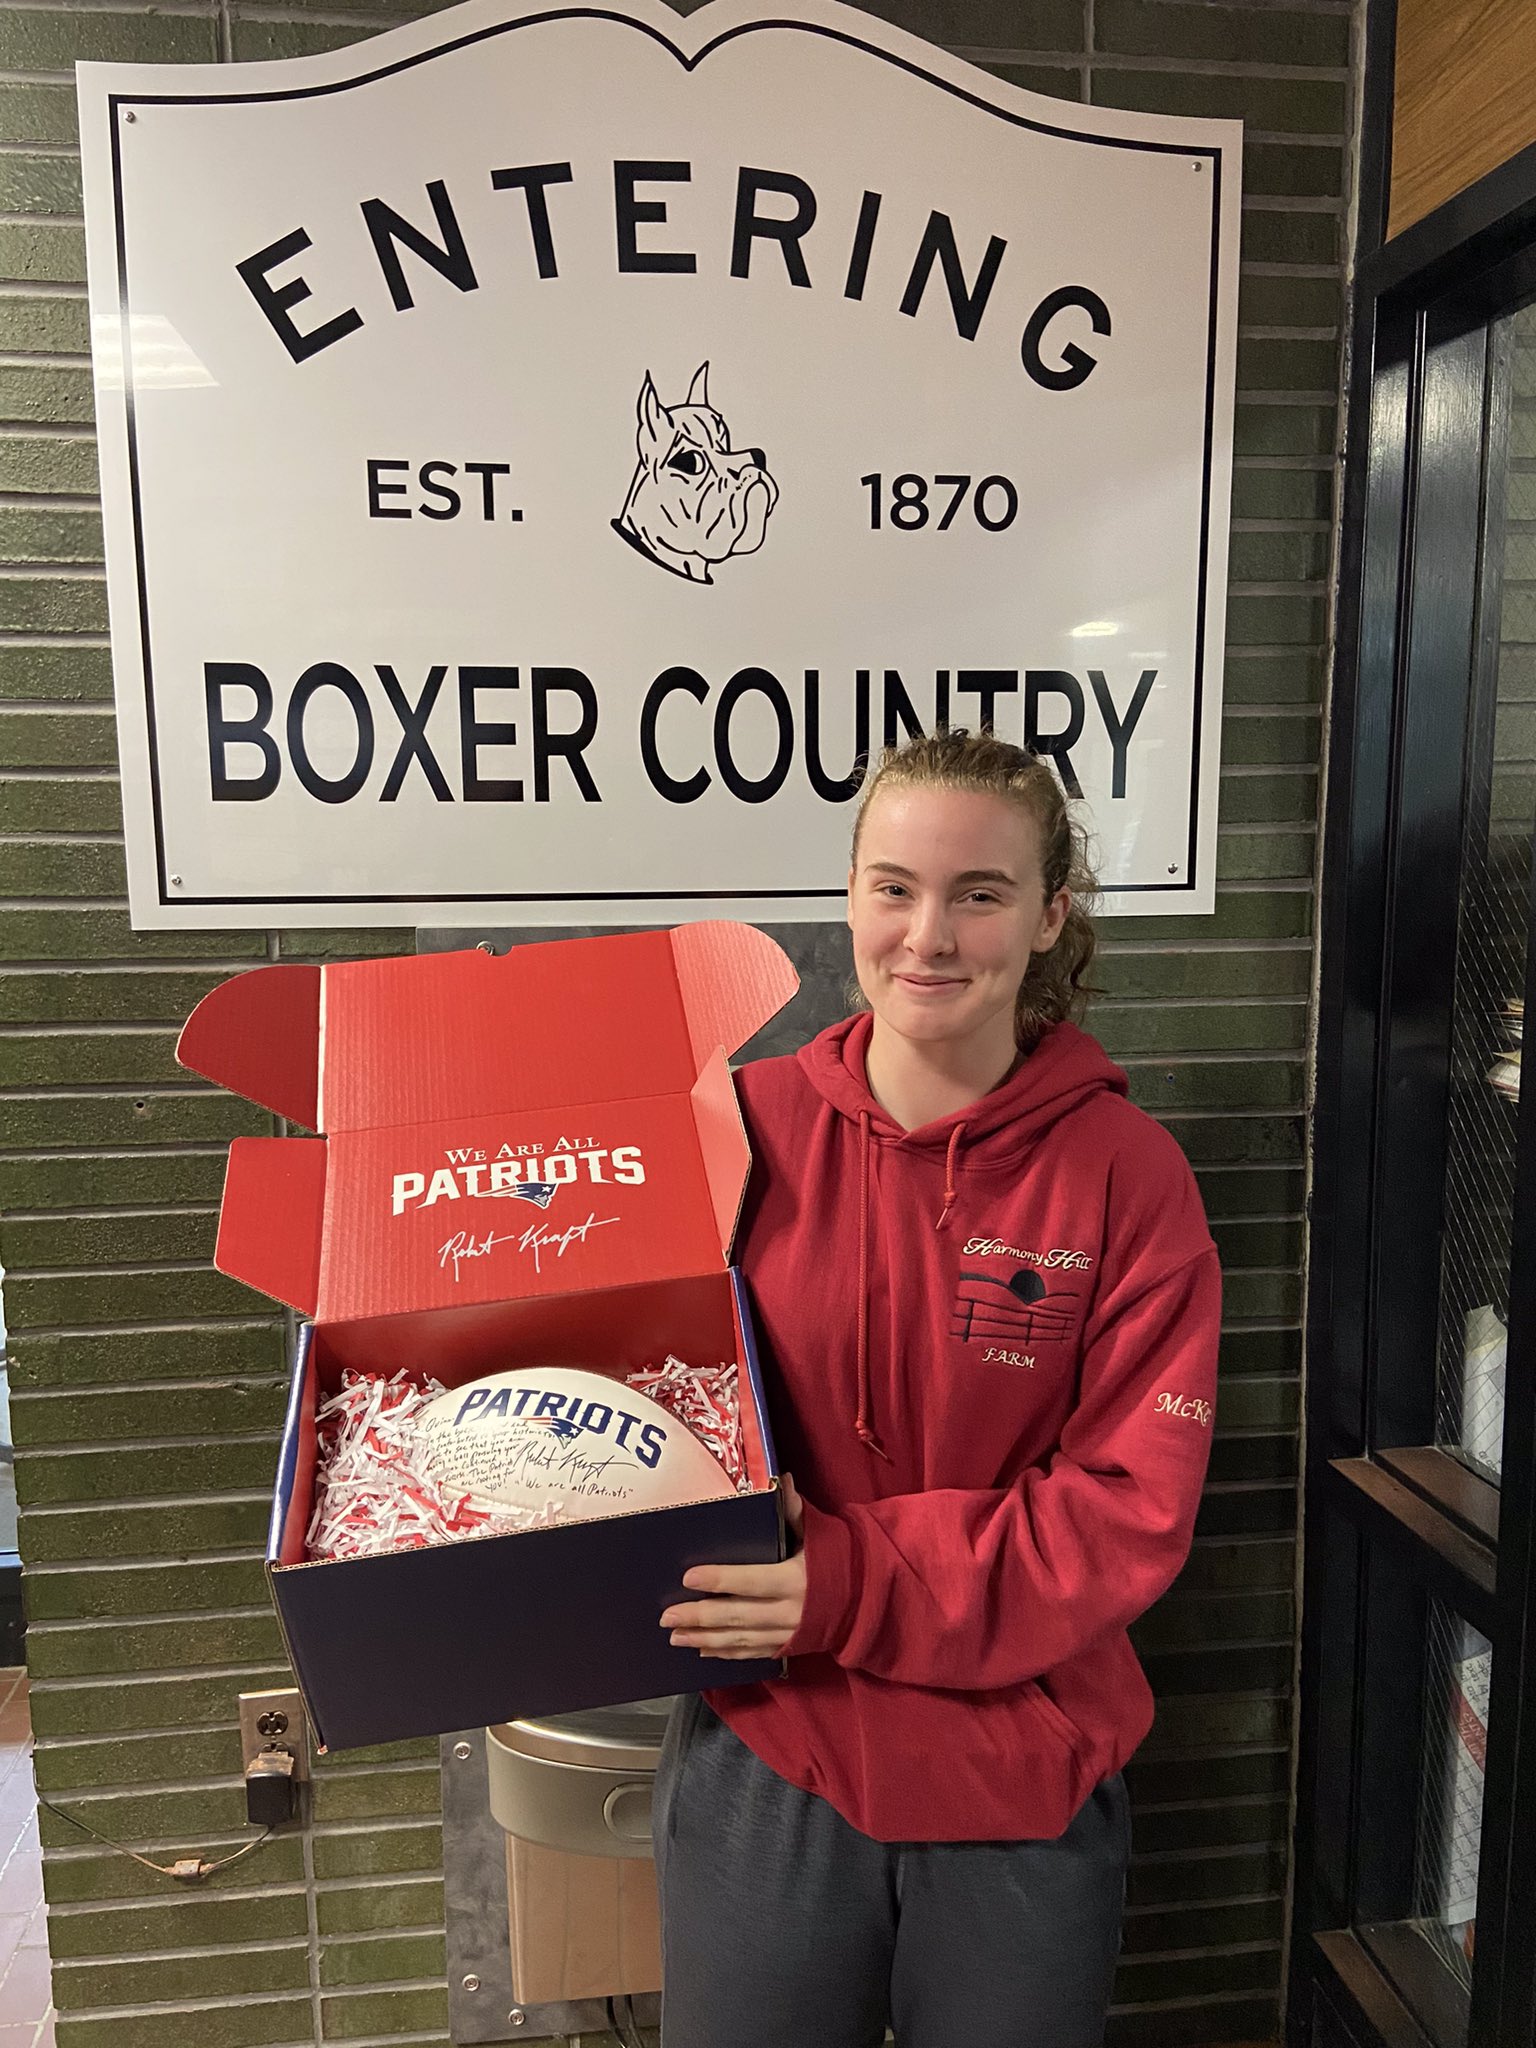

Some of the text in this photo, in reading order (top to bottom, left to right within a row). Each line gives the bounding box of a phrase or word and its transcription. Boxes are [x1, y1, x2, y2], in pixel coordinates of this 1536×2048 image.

[236, 160, 1112, 392] ENTERING
[366, 458, 1019, 532] EST. 1870
[203, 661, 603, 804] BOXER
[390, 1146, 646, 1217] PATRIOTS
[962, 1237, 1094, 1271] Harmony Hill
[981, 1347, 1036, 1369] FARM
[452, 1387, 668, 1469] PATRIOTS
